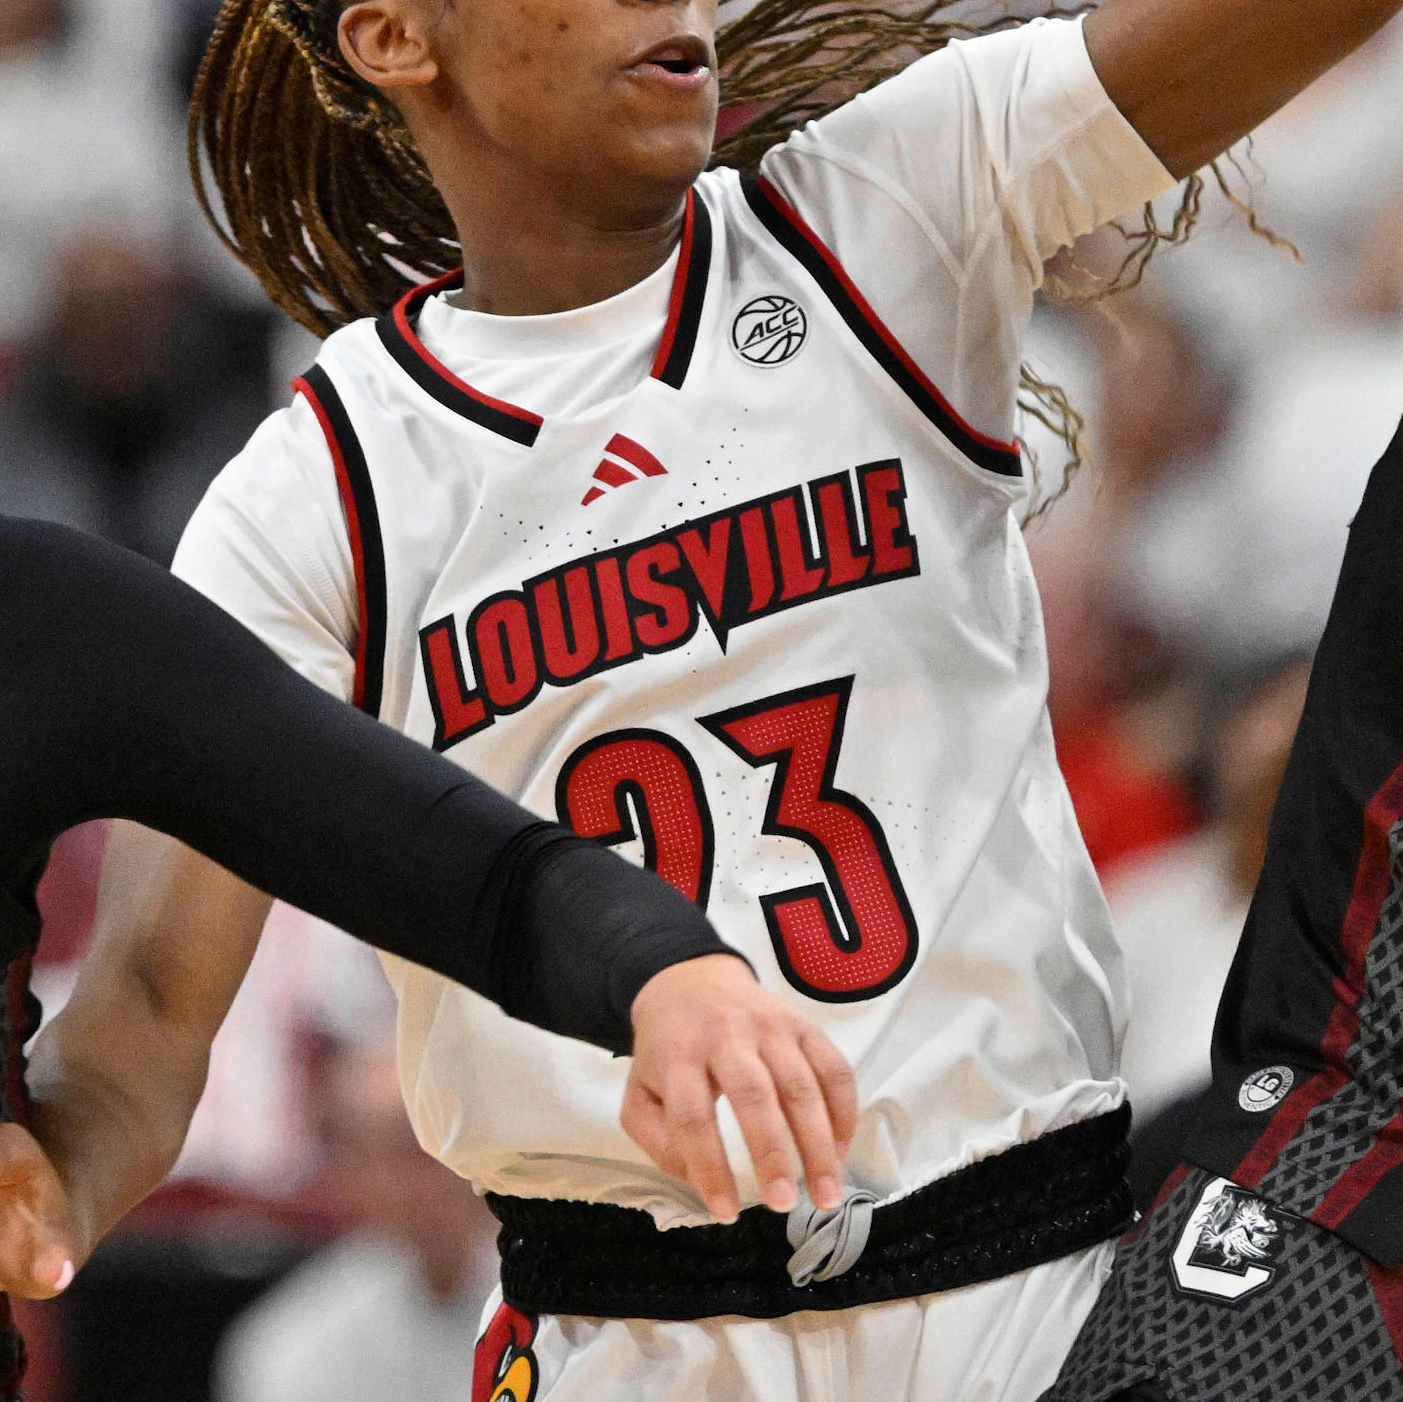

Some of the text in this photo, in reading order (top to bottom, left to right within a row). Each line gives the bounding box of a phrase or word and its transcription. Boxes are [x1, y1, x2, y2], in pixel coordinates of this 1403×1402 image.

[743, 304, 798, 345] ACC
[418, 458, 921, 752] LOUISVILLE
[555, 674, 920, 1004] 23
